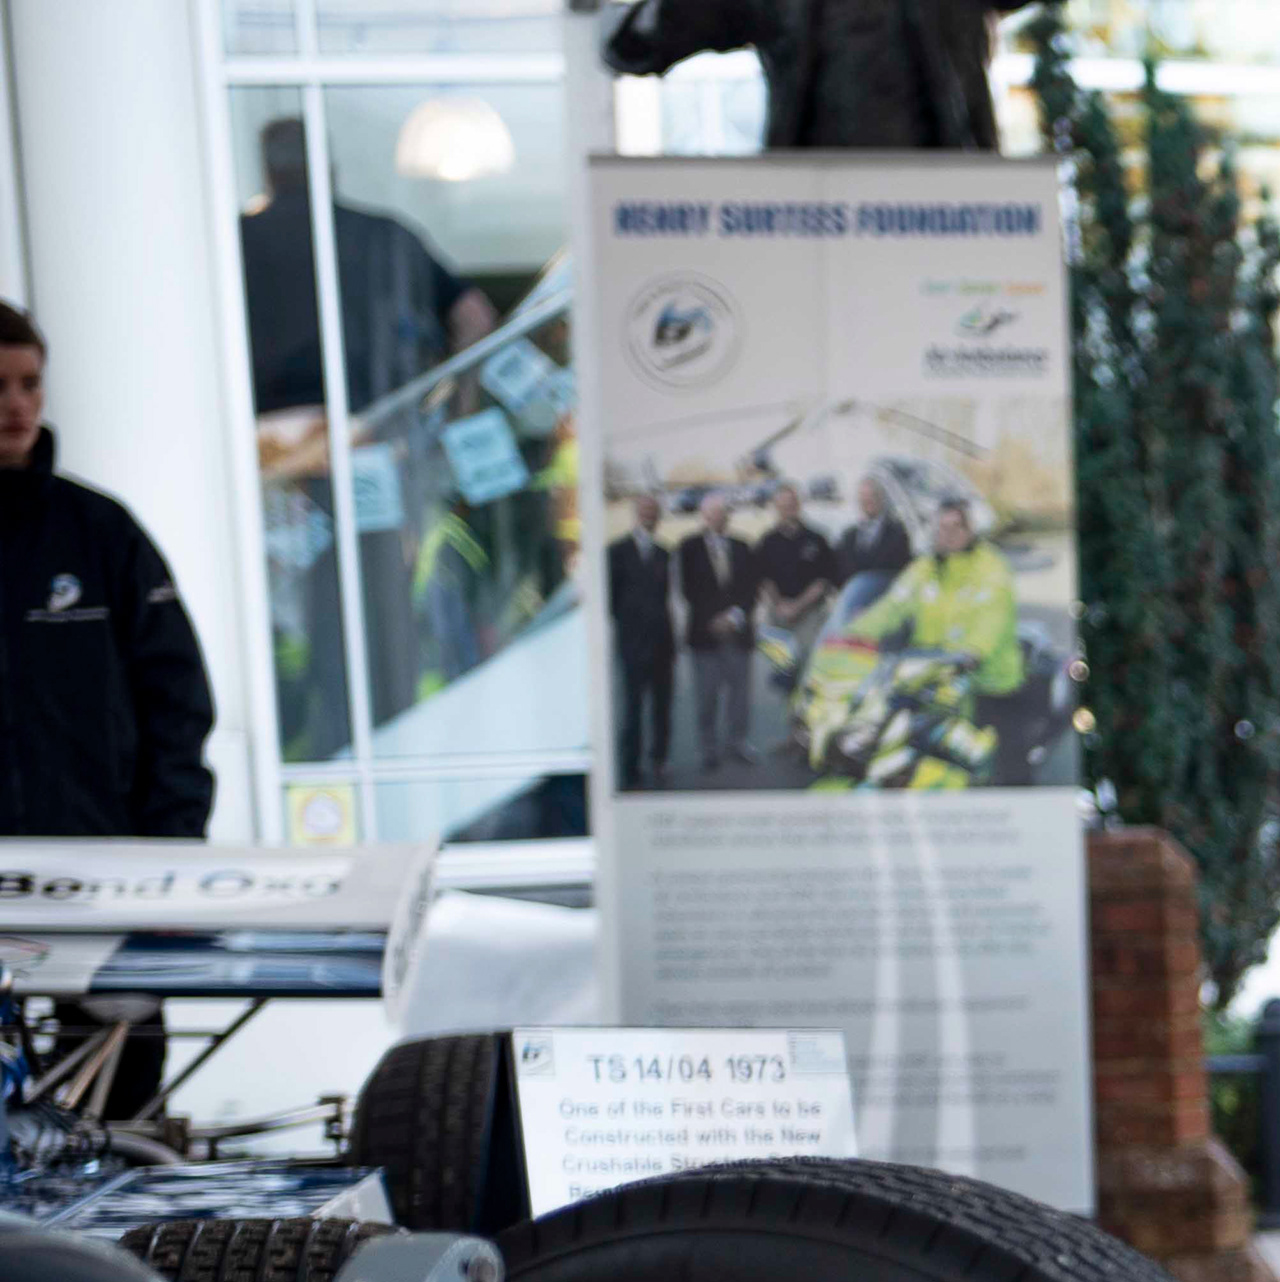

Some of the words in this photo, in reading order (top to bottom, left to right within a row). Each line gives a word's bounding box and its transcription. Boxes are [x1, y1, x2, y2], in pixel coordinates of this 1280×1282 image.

[614, 203, 709, 236] HENRY
[718, 203, 846, 236] SURTEES
[857, 203, 1041, 236] FOUNDATION
[588, 1054, 628, 1083] TS
[635, 1054, 712, 1083] 14/04
[726, 1054, 786, 1083] 1973
[558, 1098, 599, 1118] One
[606, 1098, 626, 1118] of
[632, 1099, 664, 1118] the
[670, 1098, 713, 1118] First
[720, 1098, 765, 1118] Cars
[772, 1099, 791, 1118] to
[797, 1099, 821, 1118] be
[564, 1126, 689, 1145] Constructed
[697, 1127, 737, 1145] with
[744, 1127, 774, 1145] the
[781, 1126, 821, 1145] New
[562, 1154, 663, 1174] Crushable
